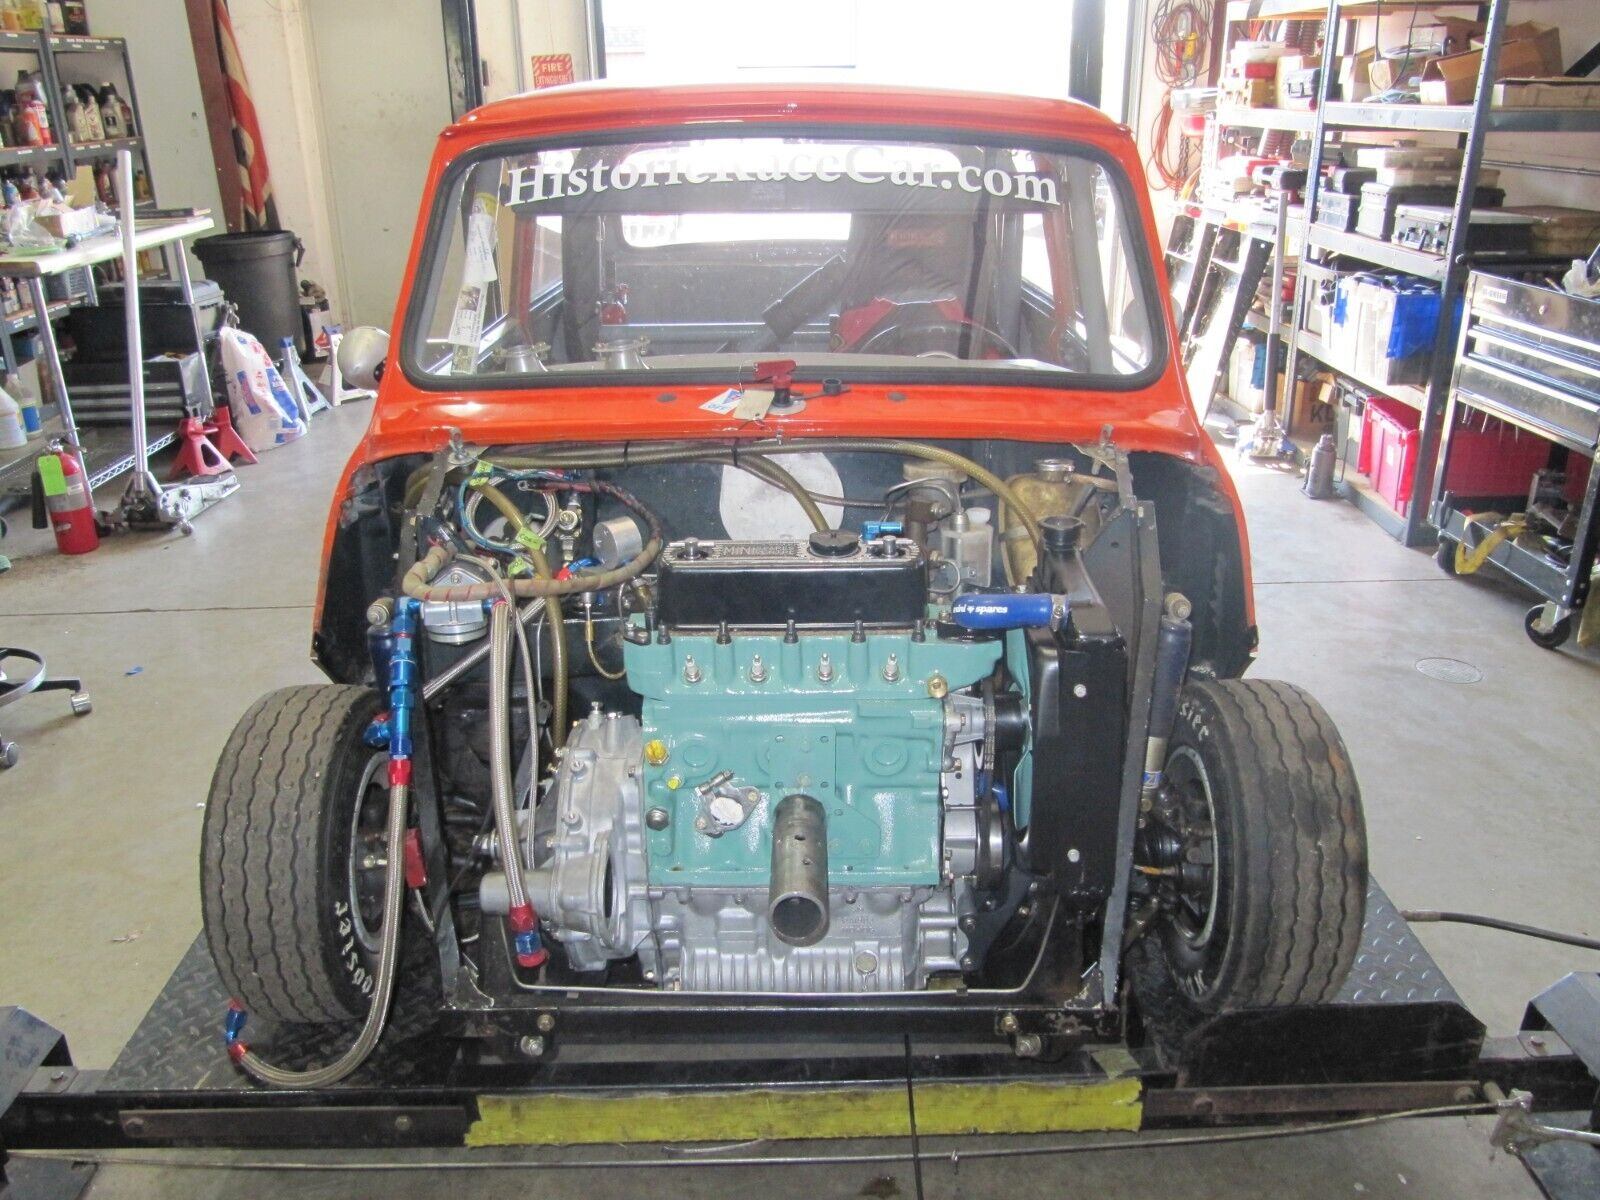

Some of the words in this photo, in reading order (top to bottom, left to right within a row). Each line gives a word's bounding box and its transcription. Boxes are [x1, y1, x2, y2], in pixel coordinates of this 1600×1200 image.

[542, 62, 563, 72] FIRE
[505, 147, 1060, 206] HistoricRaceCar.com
[975, 605, 1008, 616] spares
